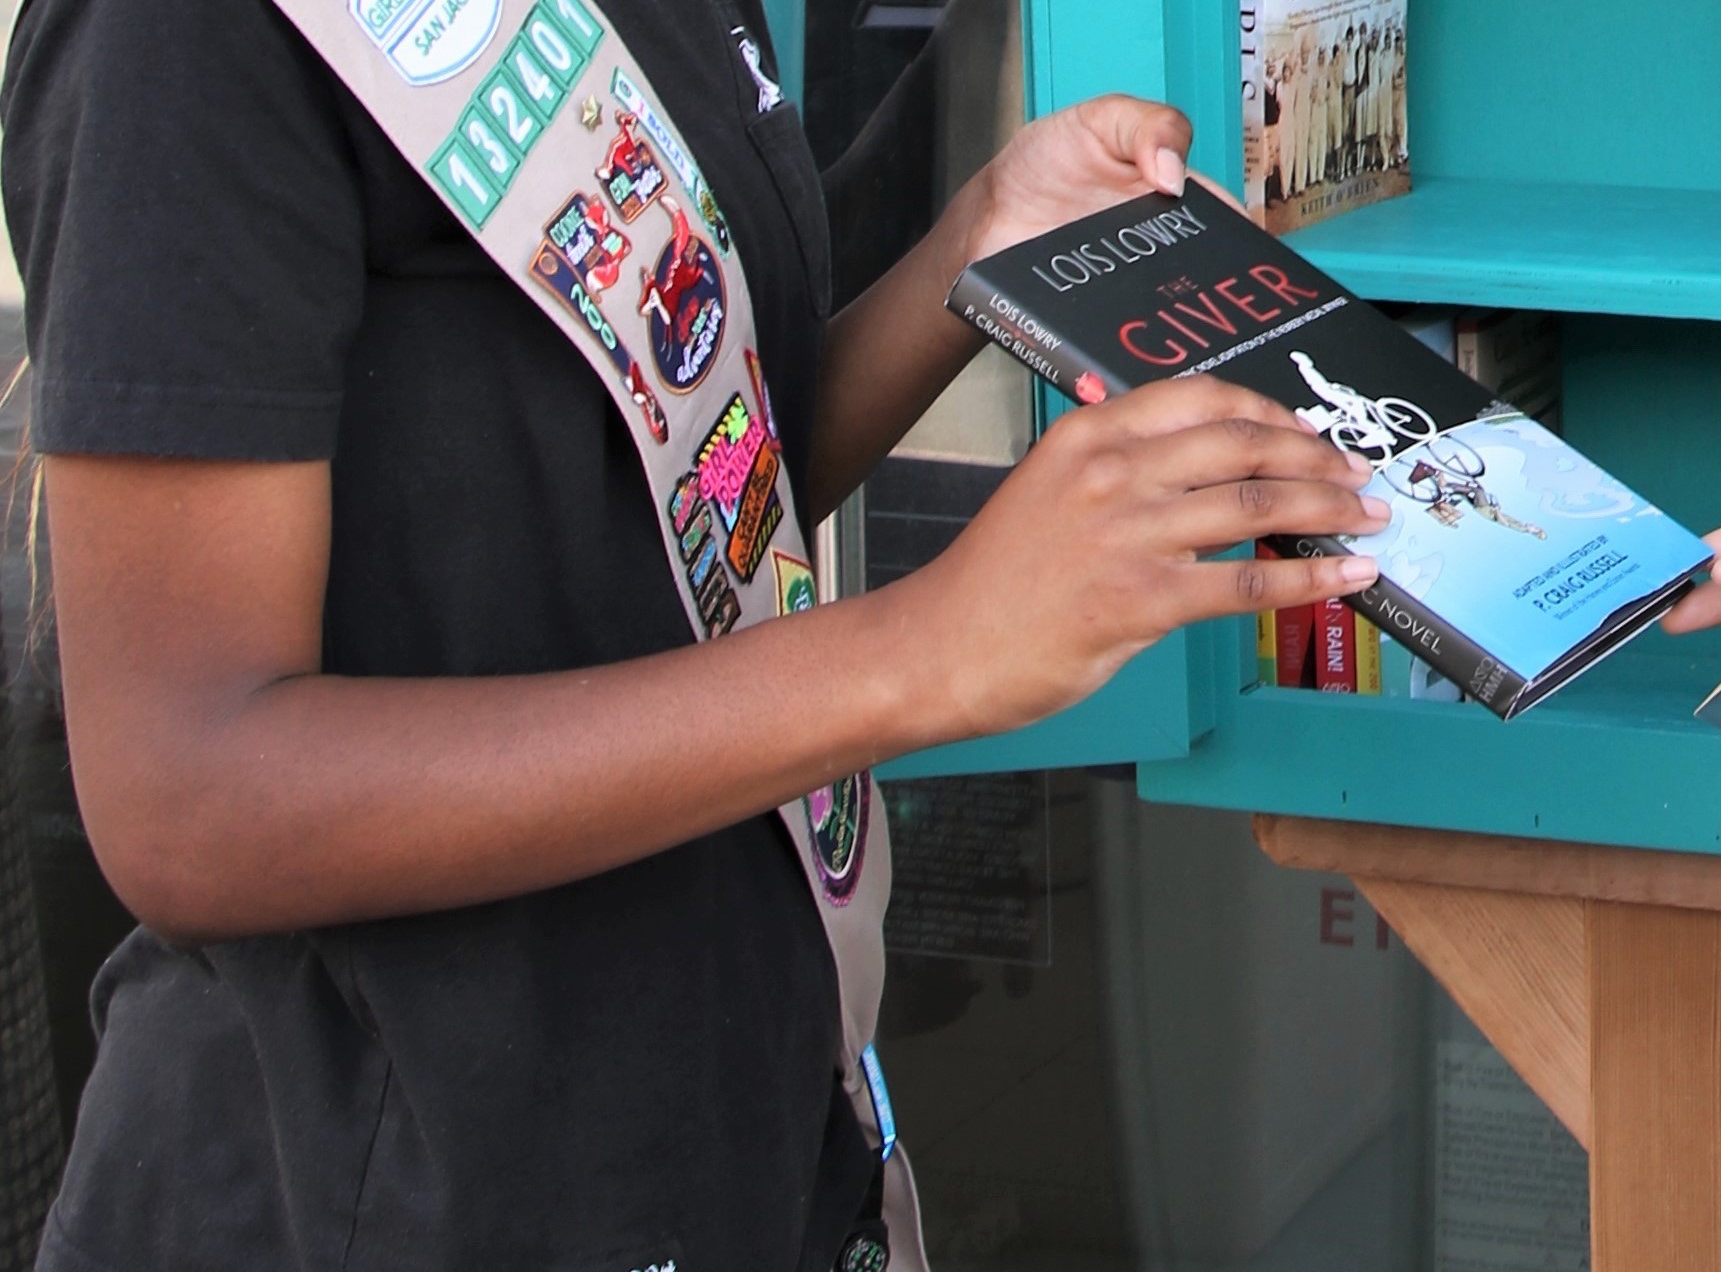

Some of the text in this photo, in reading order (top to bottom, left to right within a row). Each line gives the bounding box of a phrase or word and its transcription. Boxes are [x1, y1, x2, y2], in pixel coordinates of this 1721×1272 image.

[414, 15, 447, 57] SAN
[647, 112, 686, 170] BOLD
[1031, 204, 1208, 293] LOIS LOWRY
[570, 282, 618, 351] 200
[1118, 262, 1320, 366] GIVER
[1156, 274, 1200, 300] THE
[964, 304, 1060, 384] P. CRAIG RUSSELL
[988, 293, 1062, 351] LOIS LOWRY
[698, 435, 735, 501] GIRL
[714, 413, 766, 515] POWER
[1532, 598, 1552, 613] P.
[1544, 576, 1585, 605] CRAIG
[1576, 549, 1629, 582] RUSSELL
[1326, 626, 1344, 673] RAIN!
[1378, 598, 1444, 656] NOVEL
